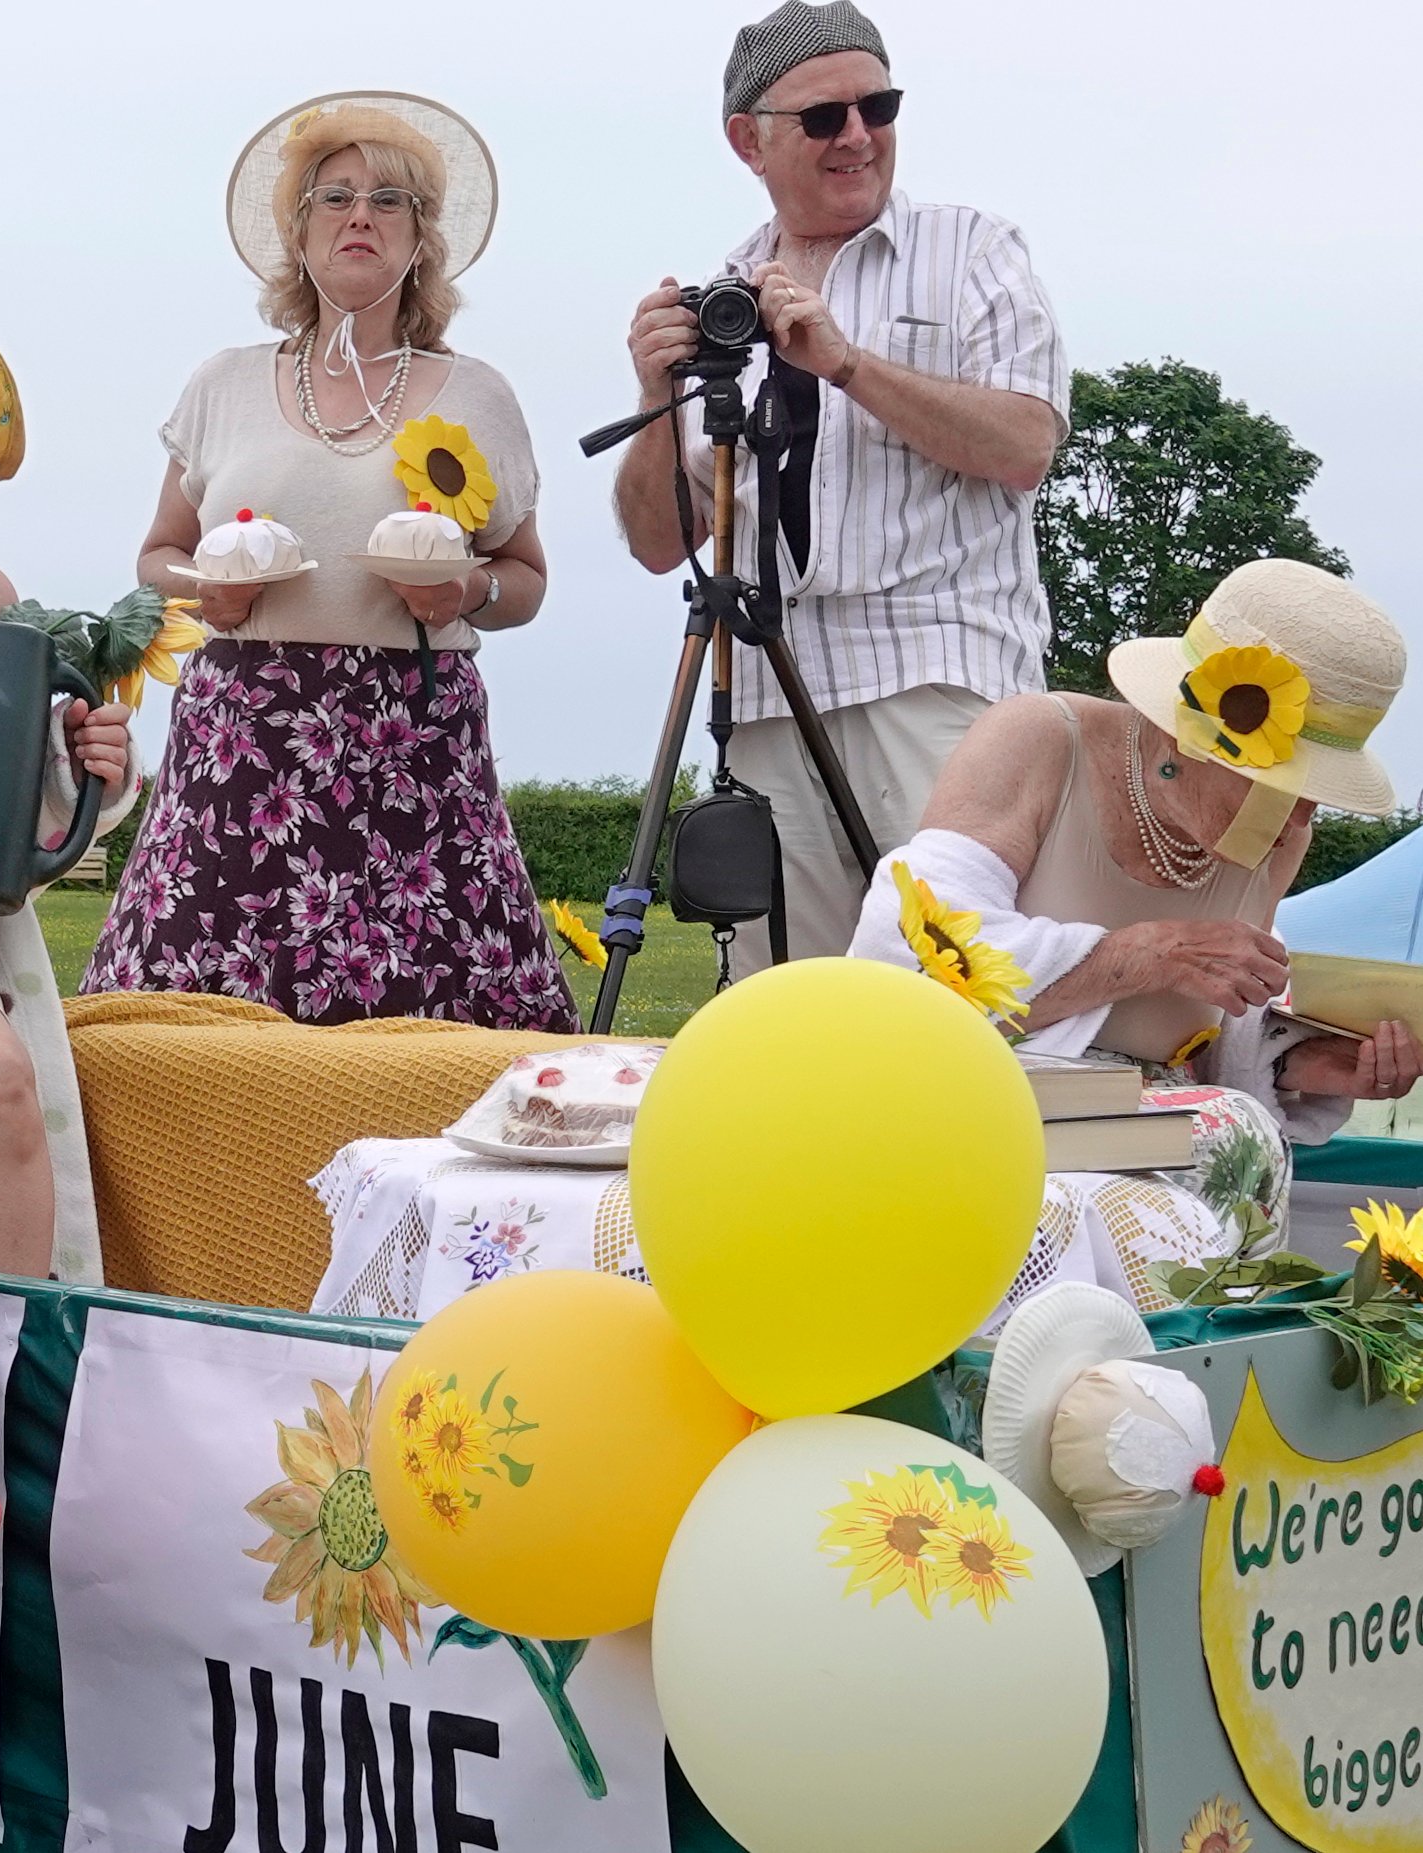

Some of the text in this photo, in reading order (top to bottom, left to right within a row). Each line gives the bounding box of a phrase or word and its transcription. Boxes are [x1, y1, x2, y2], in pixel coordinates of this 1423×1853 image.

[1251, 1608, 1306, 1690] to
[182, 1657, 500, 1853] JUNE
[1304, 1726, 1422, 1812] bigge
